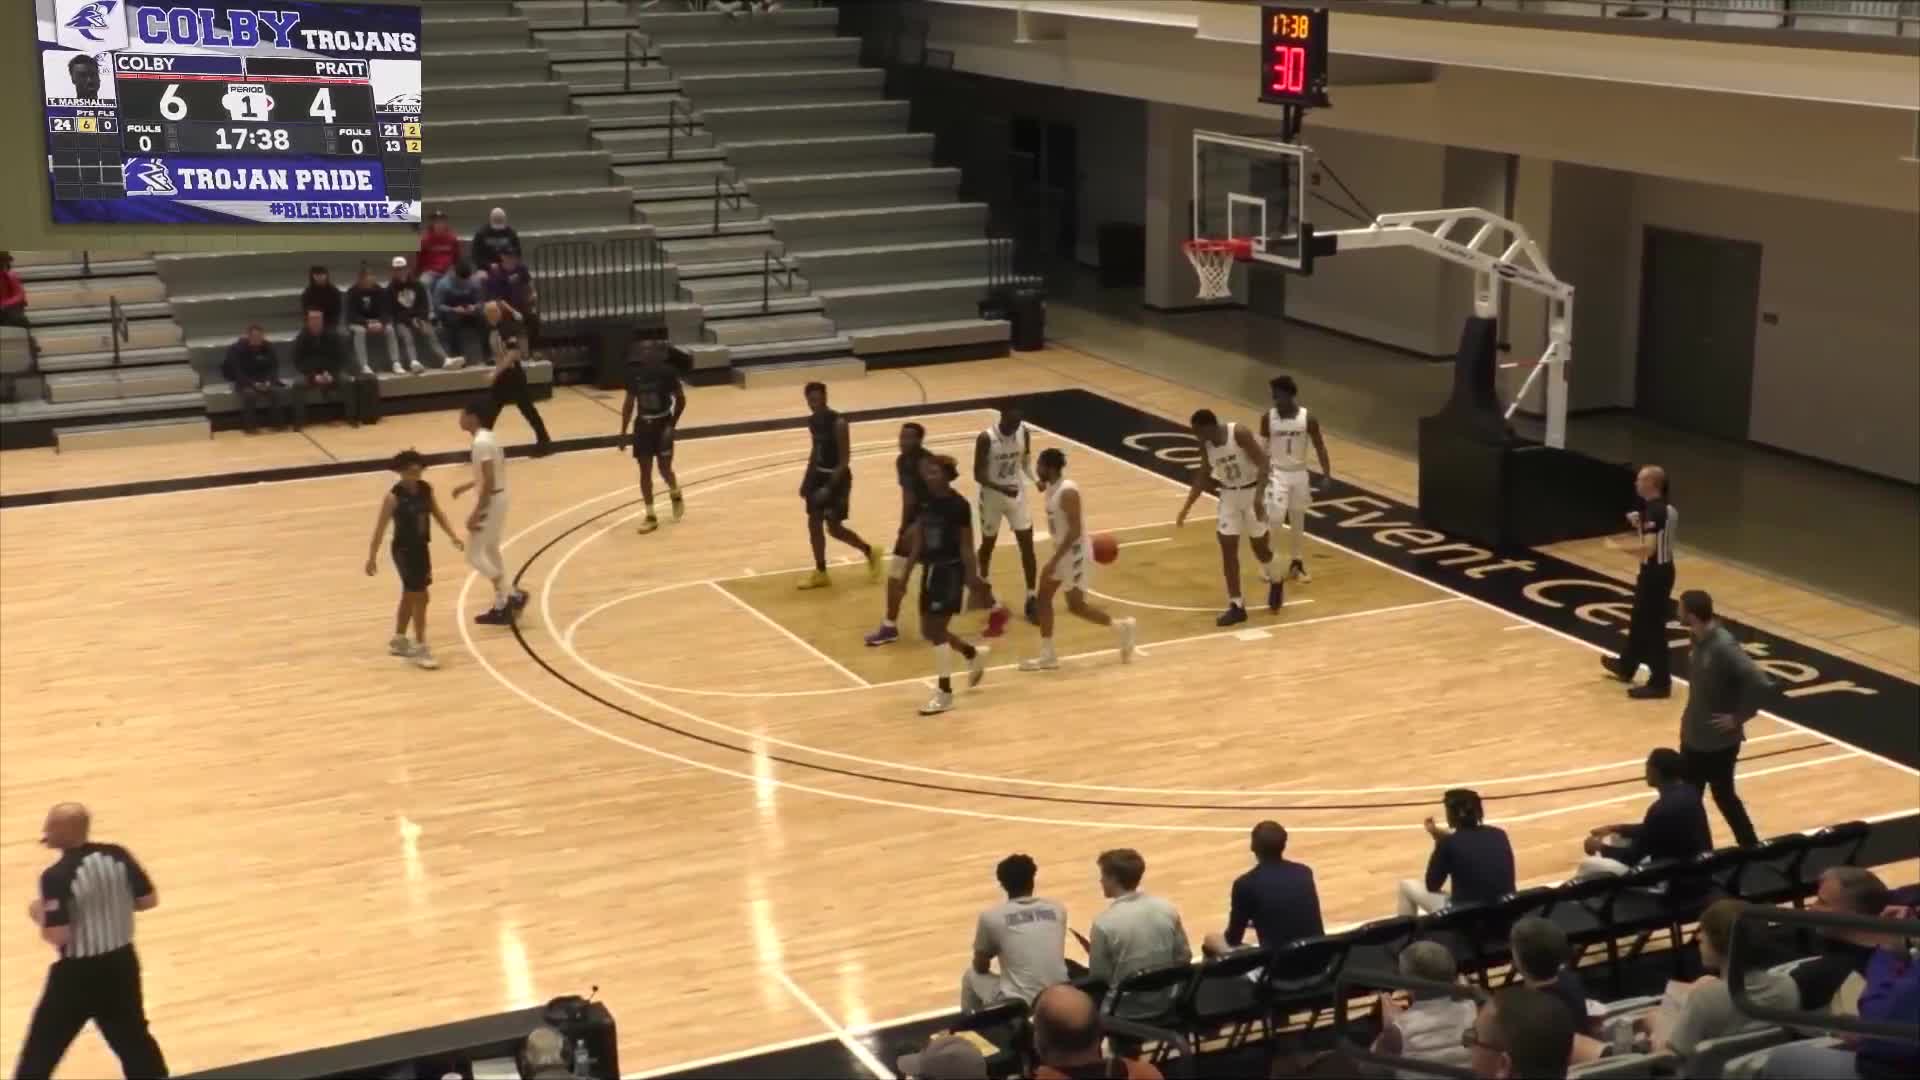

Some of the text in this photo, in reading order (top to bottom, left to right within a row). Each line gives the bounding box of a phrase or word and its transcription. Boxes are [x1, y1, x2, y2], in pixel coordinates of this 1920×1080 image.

[1273, 14, 1309, 39] 17:38
[1272, 46, 1305, 92] 30
[1304, 496, 1537, 579] Event
